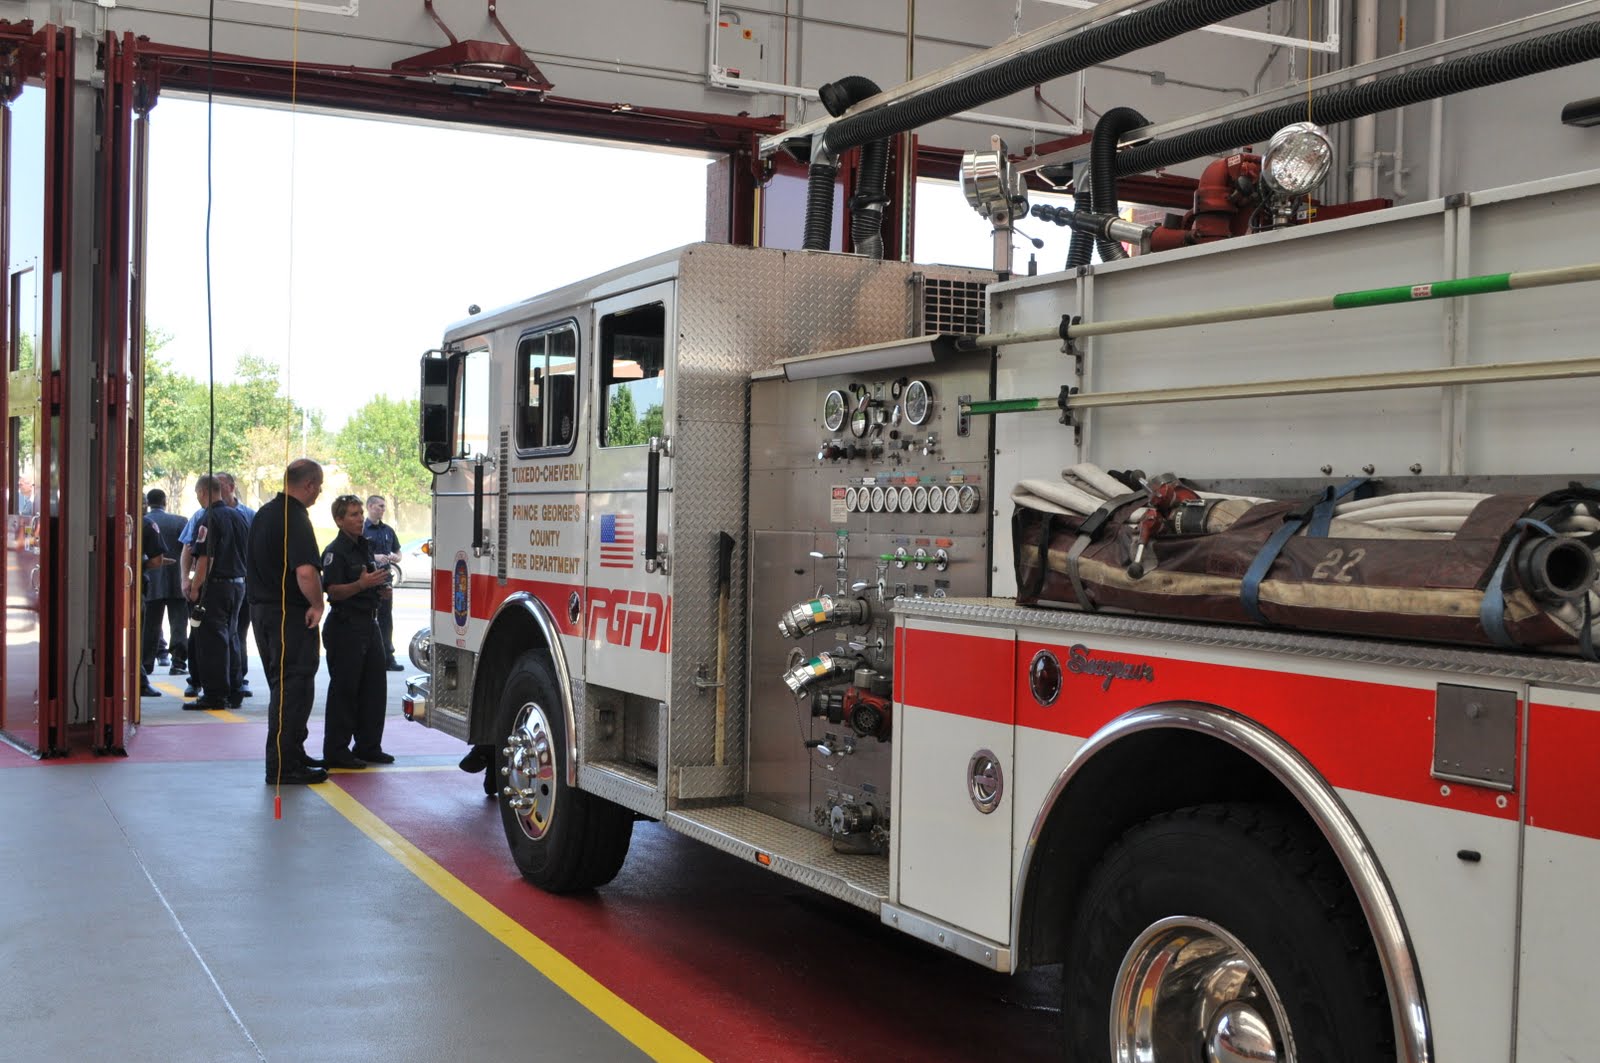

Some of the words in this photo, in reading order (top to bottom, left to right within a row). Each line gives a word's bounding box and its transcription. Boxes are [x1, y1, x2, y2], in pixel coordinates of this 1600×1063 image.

[512, 463, 583, 483] TUXEDO-CHEVERLY
[512, 504, 538, 521] PRINCE
[541, 504, 580, 522] GEORGE'S
[529, 529, 560, 547] COUNTY
[511, 553, 527, 570] FIRE
[529, 554, 580, 575] DEPARTMENT
[1312, 548, 1366, 582] 22
